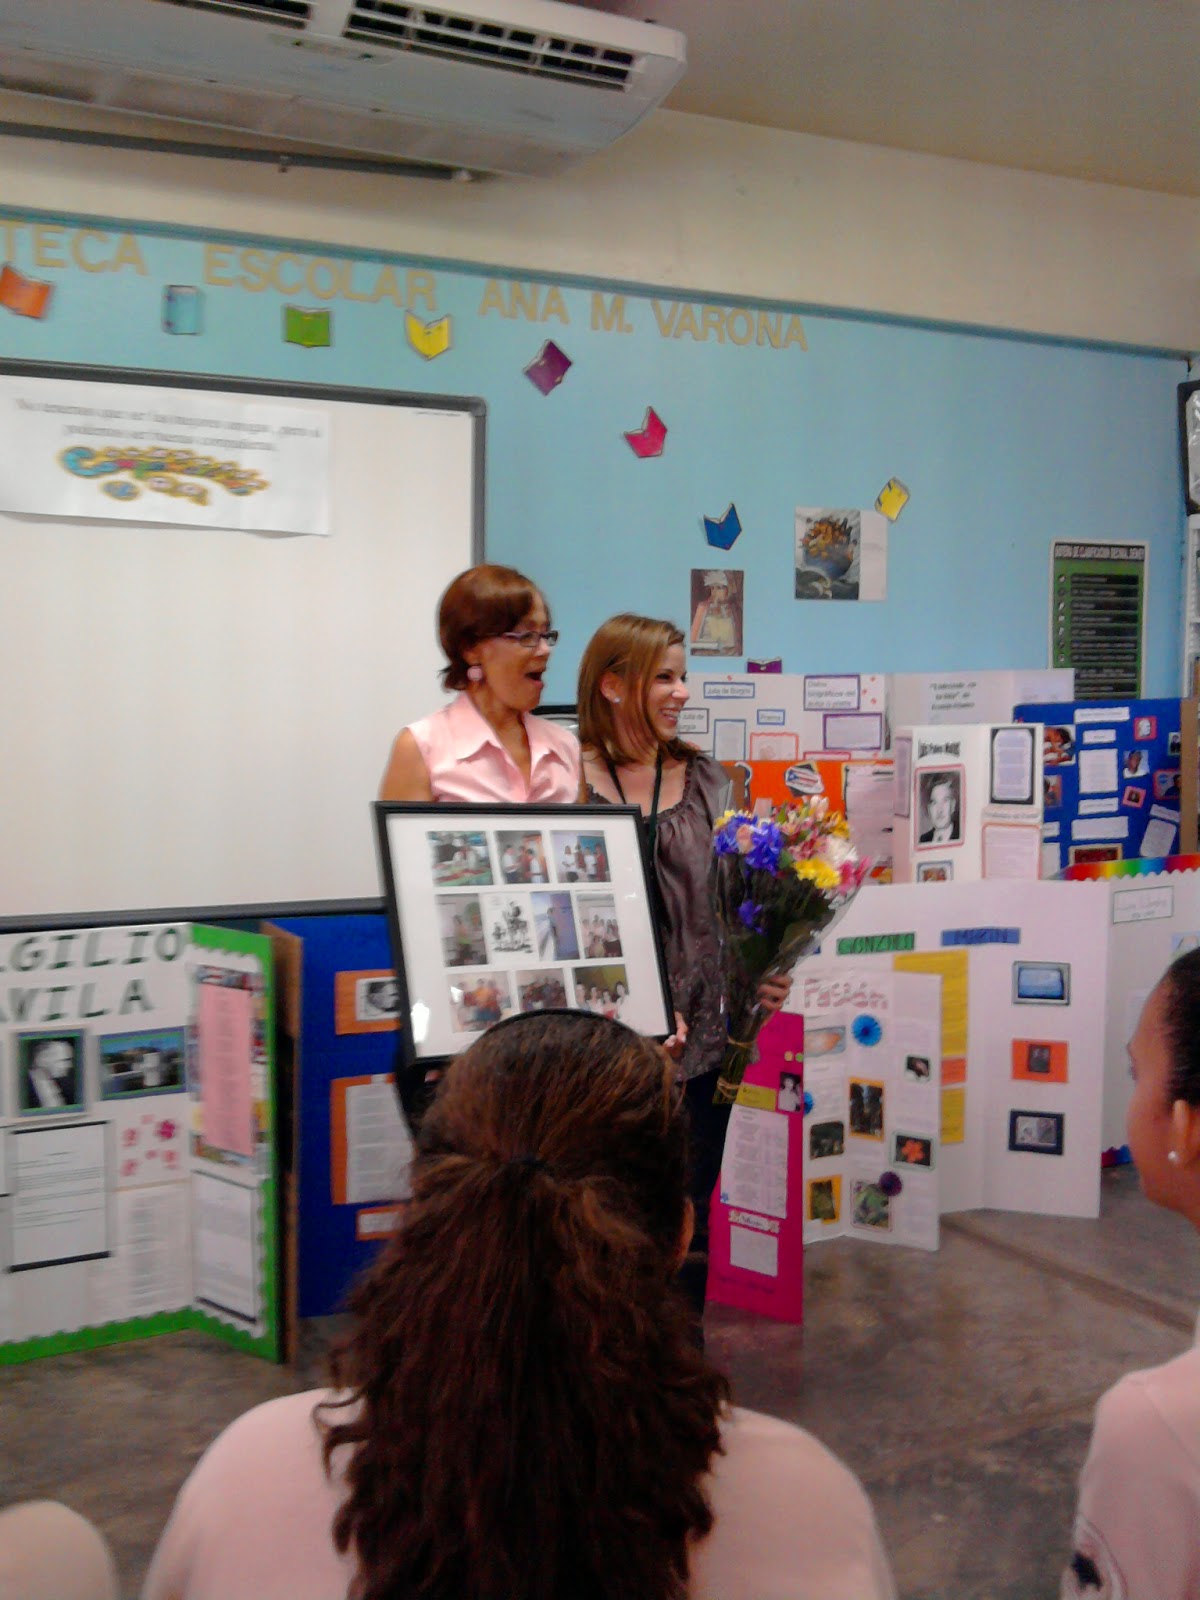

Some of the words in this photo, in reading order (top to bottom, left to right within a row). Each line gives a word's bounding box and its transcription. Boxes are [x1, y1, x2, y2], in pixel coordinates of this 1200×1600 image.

[203, 244, 438, 311] ESCOLAR
[478, 279, 571, 325] ANA
[590, 292, 634, 333] M.
[651, 300, 809, 352] VARONA
[0, 927, 186, 972] GILIO
